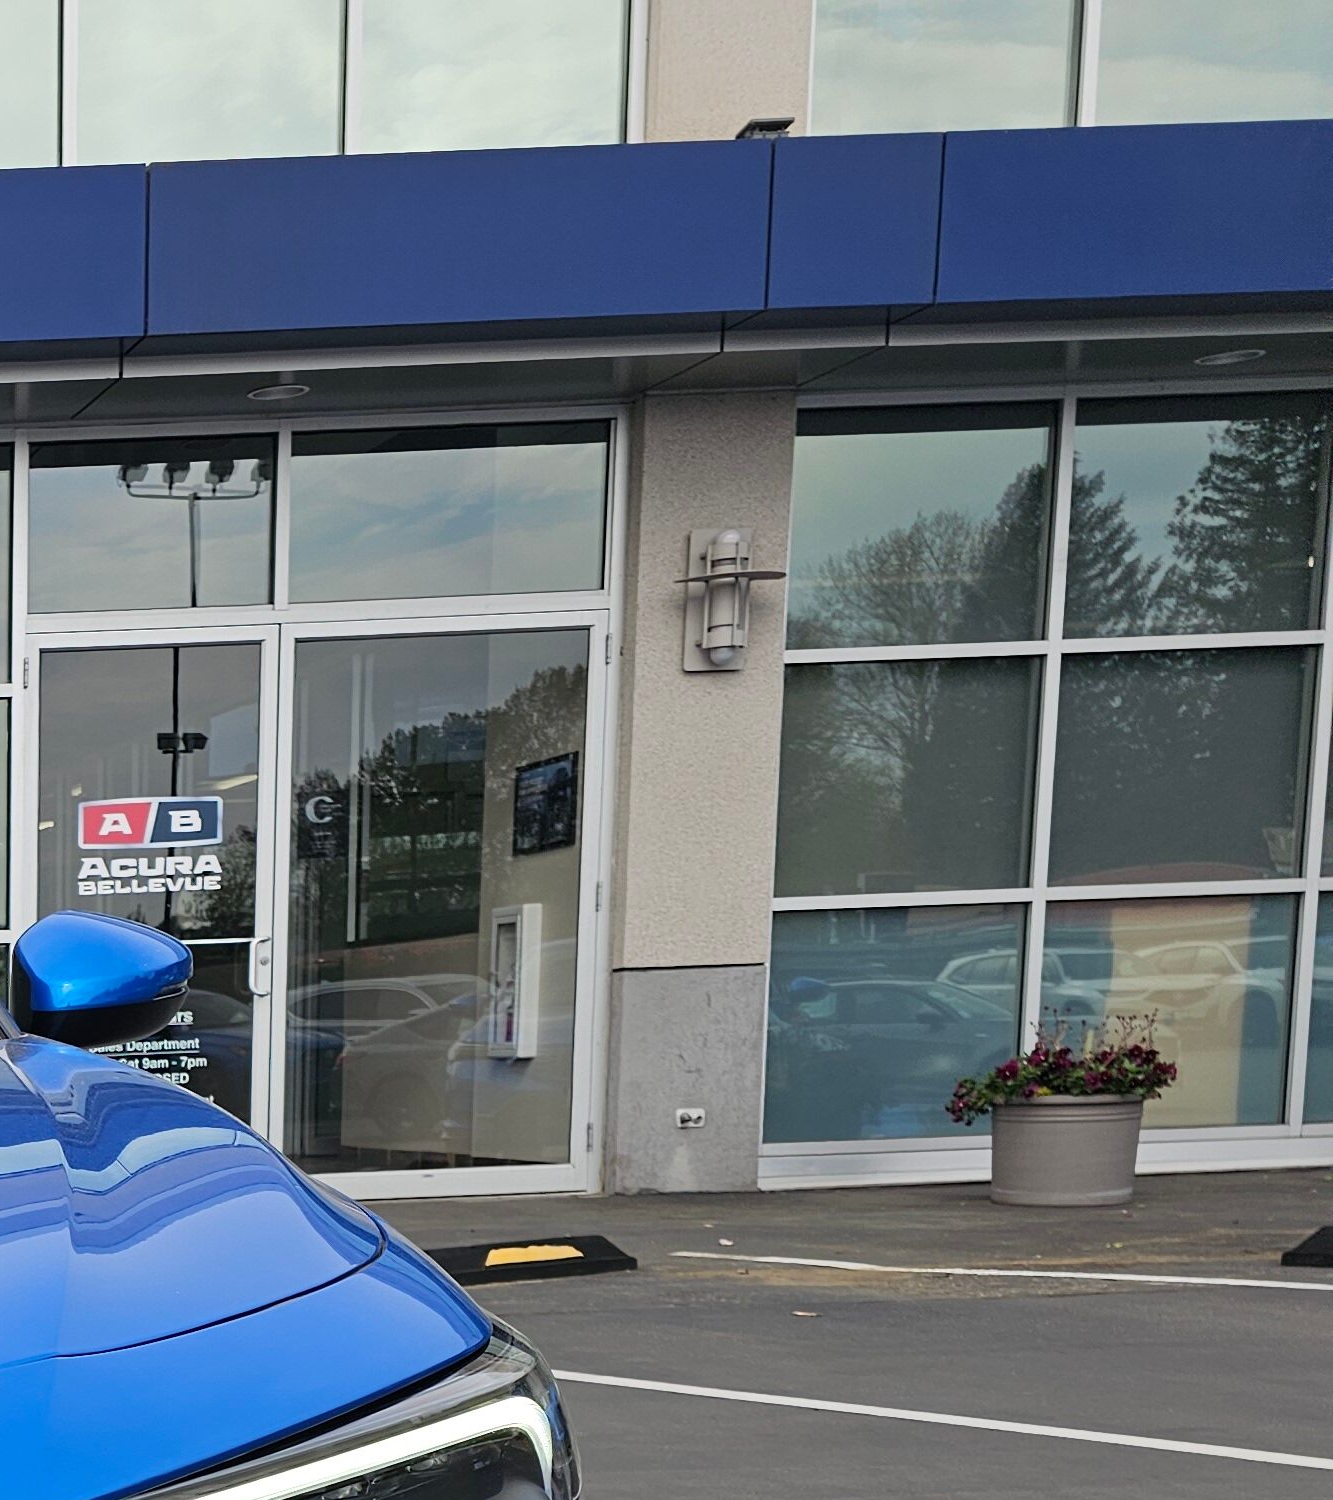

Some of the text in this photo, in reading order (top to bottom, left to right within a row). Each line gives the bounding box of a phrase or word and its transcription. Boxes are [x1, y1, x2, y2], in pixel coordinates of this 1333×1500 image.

[78, 854, 223, 879] ACURA
[78, 875, 222, 896] BELLEVUE
[126, 1038, 200, 1054] Department
[142, 1057, 169, 1069] 9am
[179, 1056, 208, 1071] 7pm
